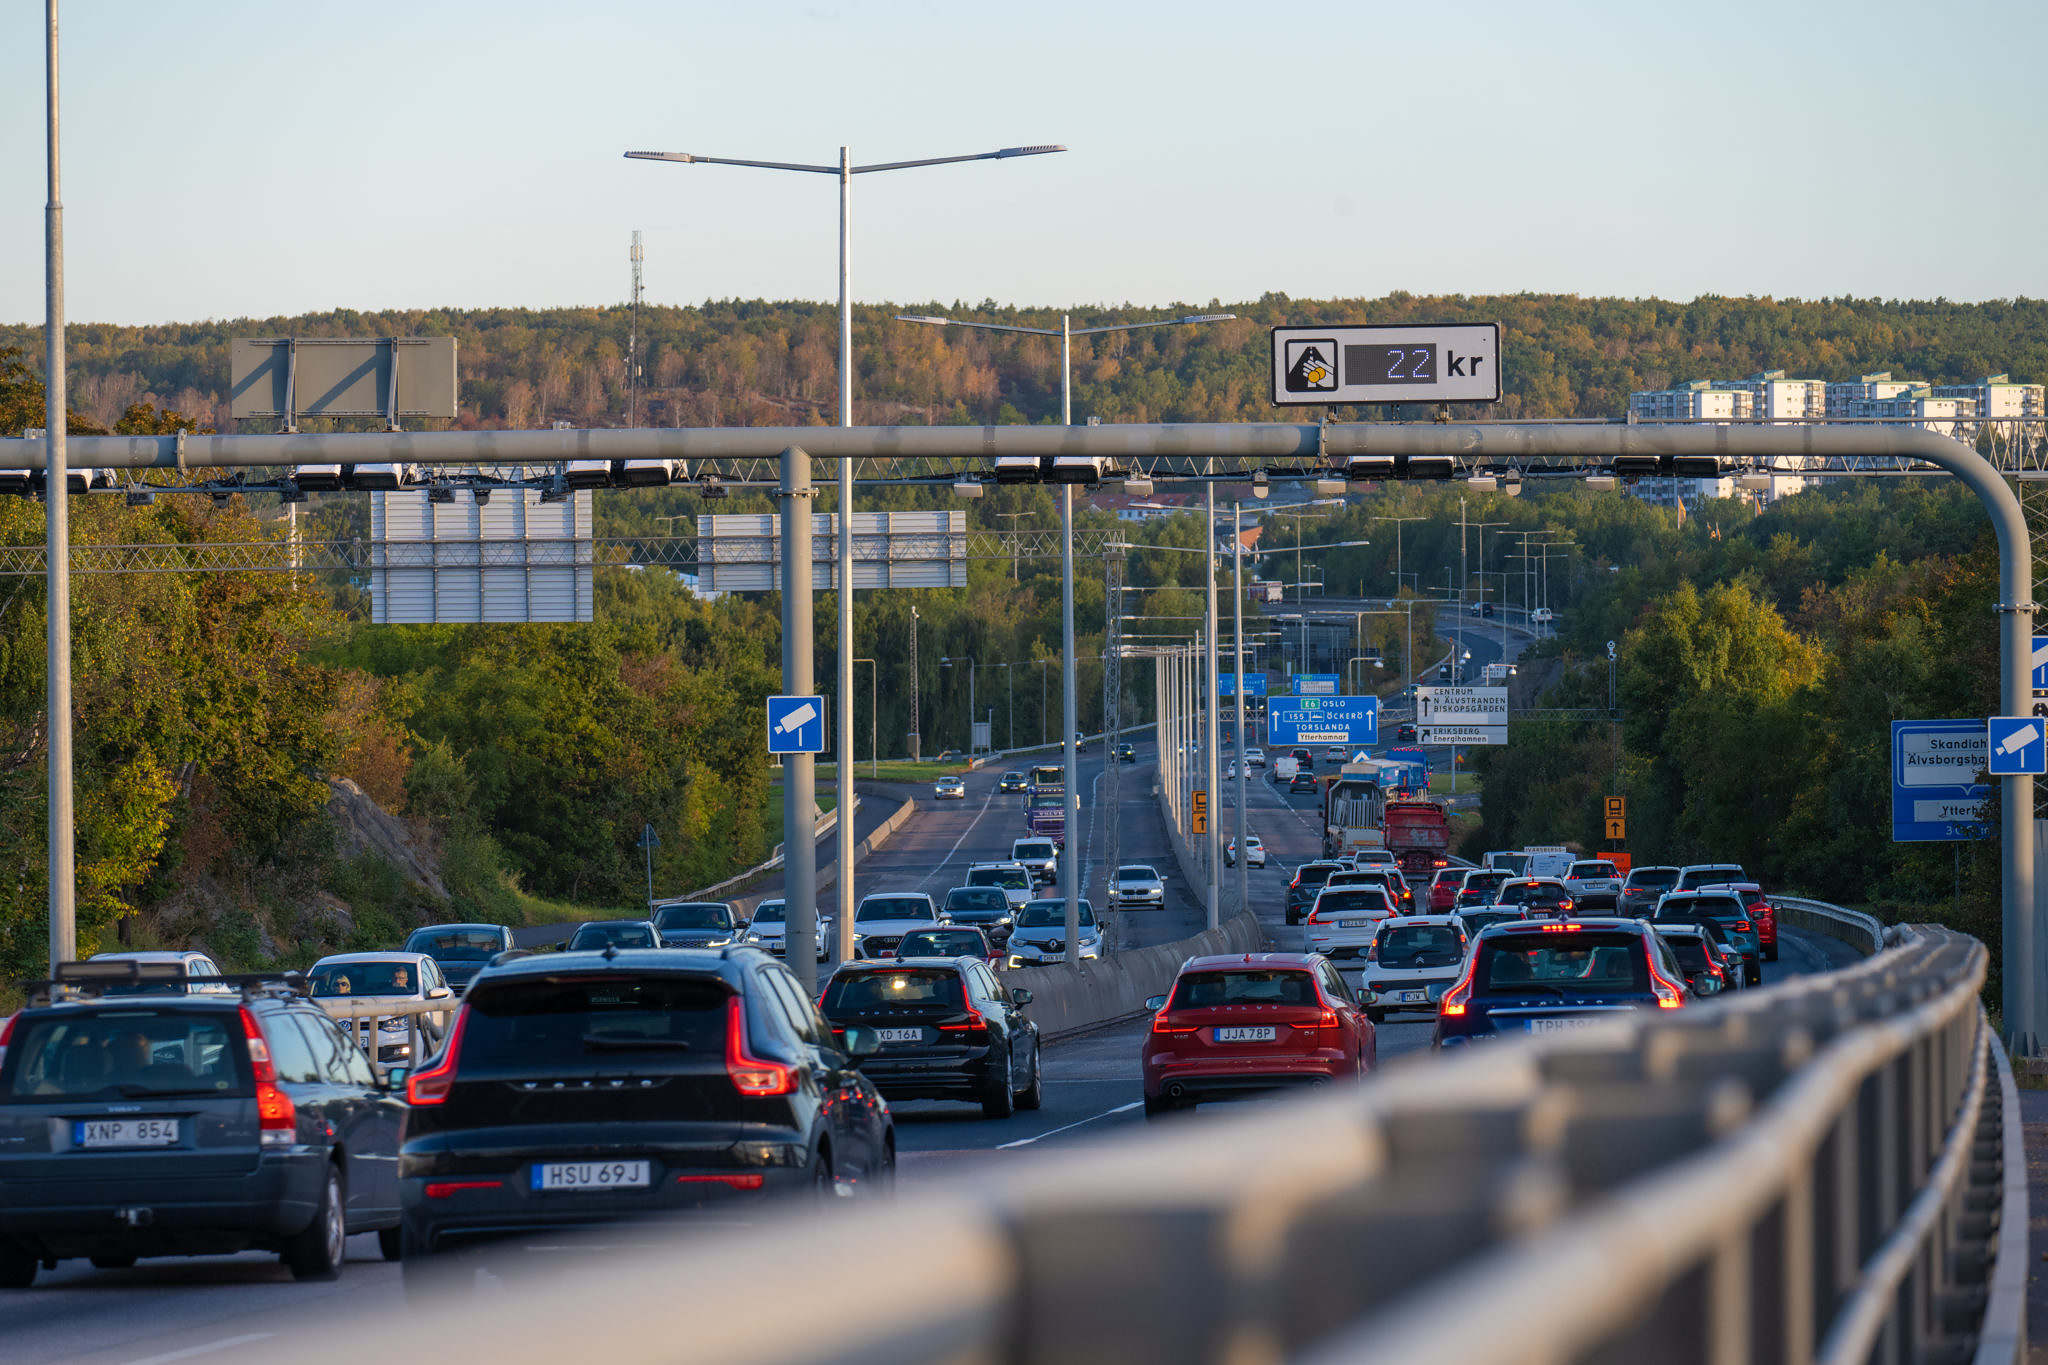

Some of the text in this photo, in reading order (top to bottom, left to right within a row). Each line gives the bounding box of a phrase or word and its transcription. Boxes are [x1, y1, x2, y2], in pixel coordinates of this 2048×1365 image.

[1387, 349, 1483, 379] 22 kr
[1305, 700, 1316, 708] E6
[1444, 696, 1506, 704] ÄLVSTRANDEN
[1433, 705, 1505, 713] BISKOPSGÅRDEN
[1326, 711, 1363, 720] ÖCKERÖ
[1296, 723, 1351, 731] TORSLANDA
[1433, 735, 1487, 743] Energihamnen
[897, 1029, 918, 1040] 16A
[1224, 1028, 1271, 1040] JJA 78P
[524, 1079, 653, 1090] VOLVO
[87, 1122, 174, 1140] XNP 854
[550, 1164, 640, 1185] HSU 69J
